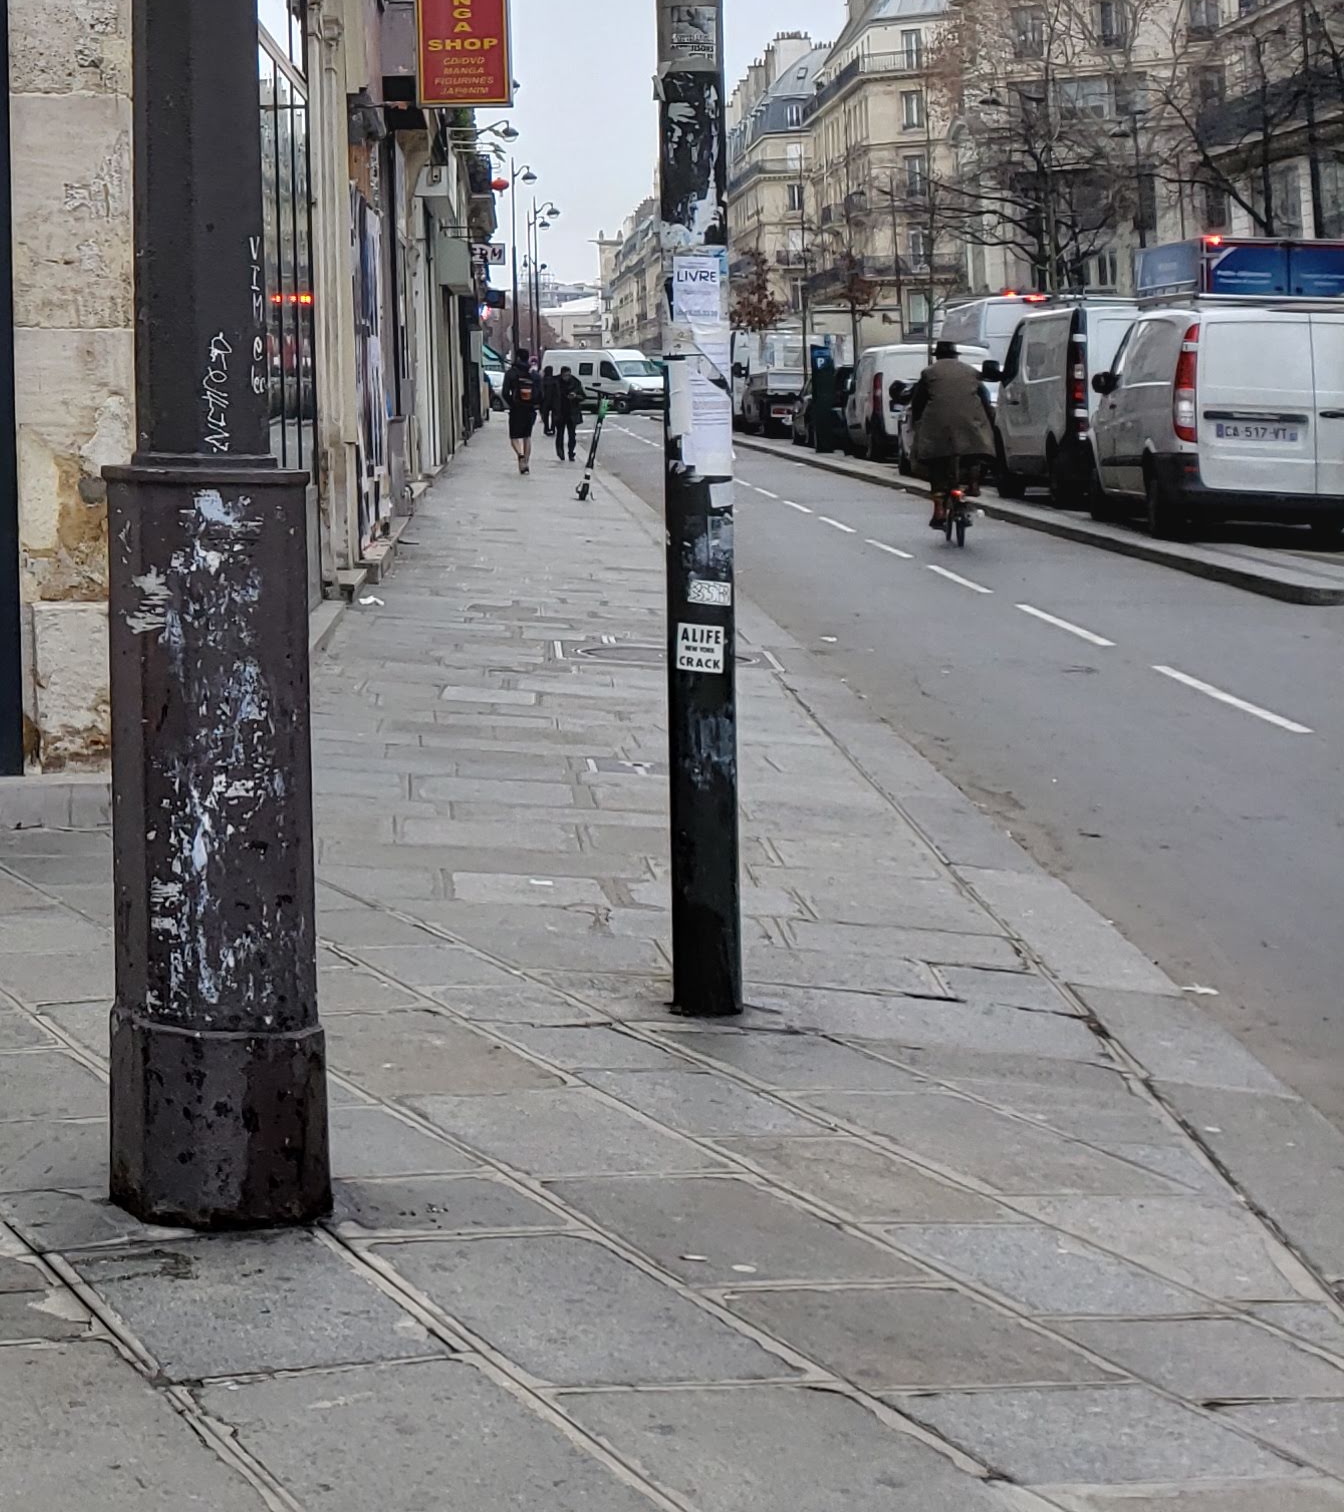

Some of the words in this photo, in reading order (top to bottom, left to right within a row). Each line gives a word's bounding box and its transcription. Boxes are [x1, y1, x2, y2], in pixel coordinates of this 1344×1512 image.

[427, 38, 498, 51] SHOP
[443, 67, 484, 75] MANGA
[434, 76, 494, 85] FIGURINES
[677, 270, 717, 283] LIVRE
[681, 627, 721, 645] ALIFE
[679, 655, 721, 669] CRACK
